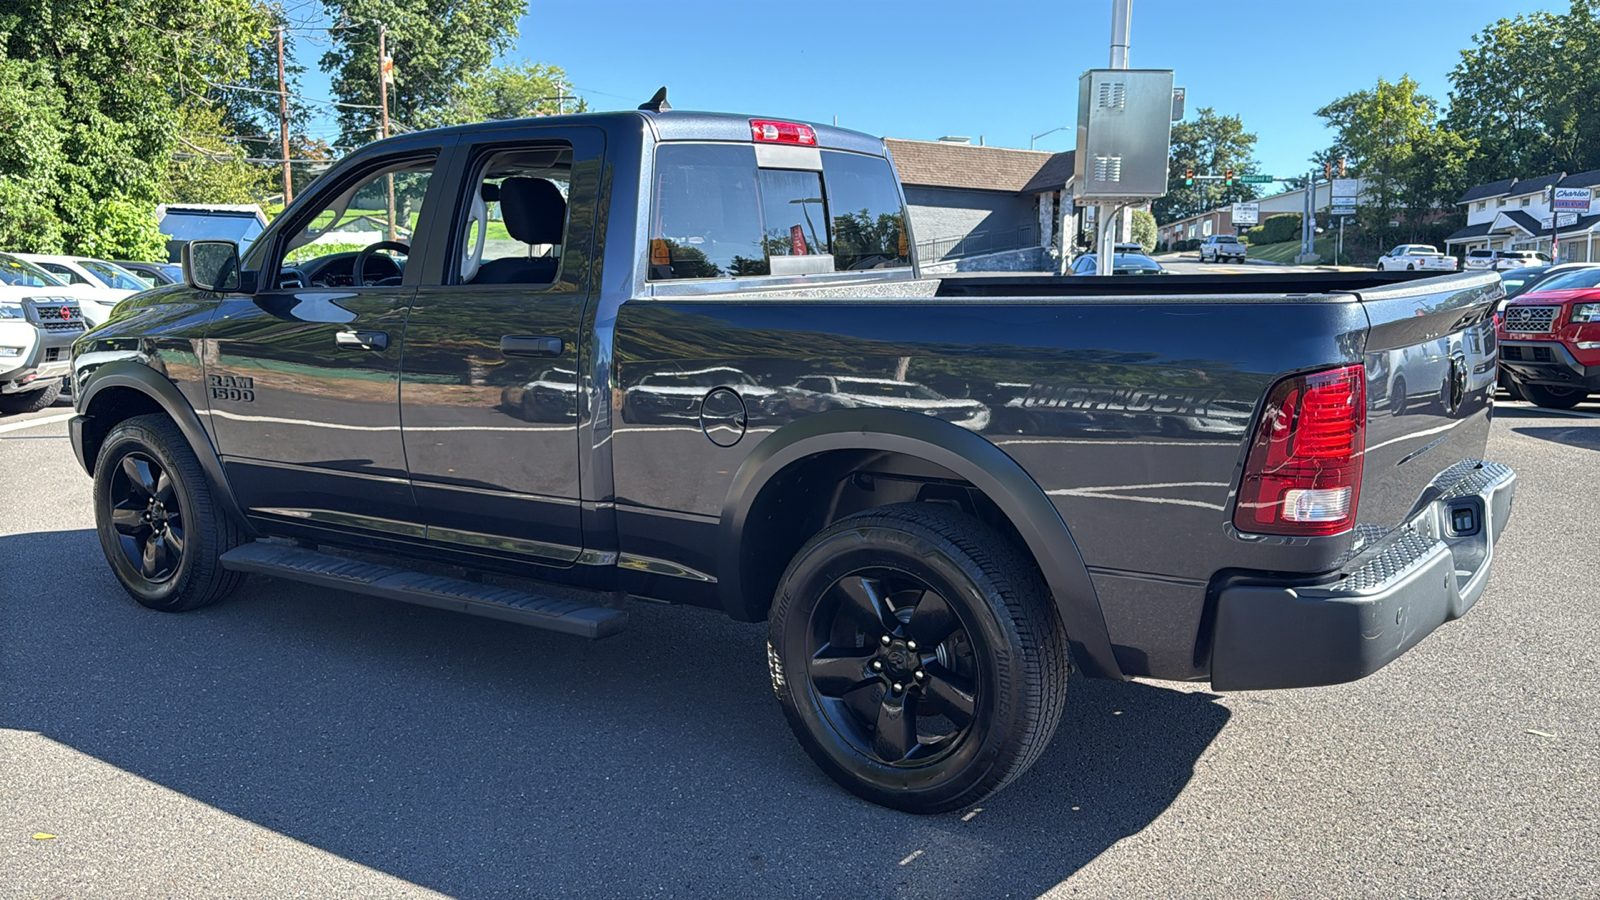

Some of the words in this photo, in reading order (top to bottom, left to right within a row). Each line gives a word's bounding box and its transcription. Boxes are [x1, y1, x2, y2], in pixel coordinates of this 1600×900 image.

[208, 374, 253, 389] RAM
[210, 387, 255, 402] 1500
[1022, 382, 1222, 417] WARLOCK
